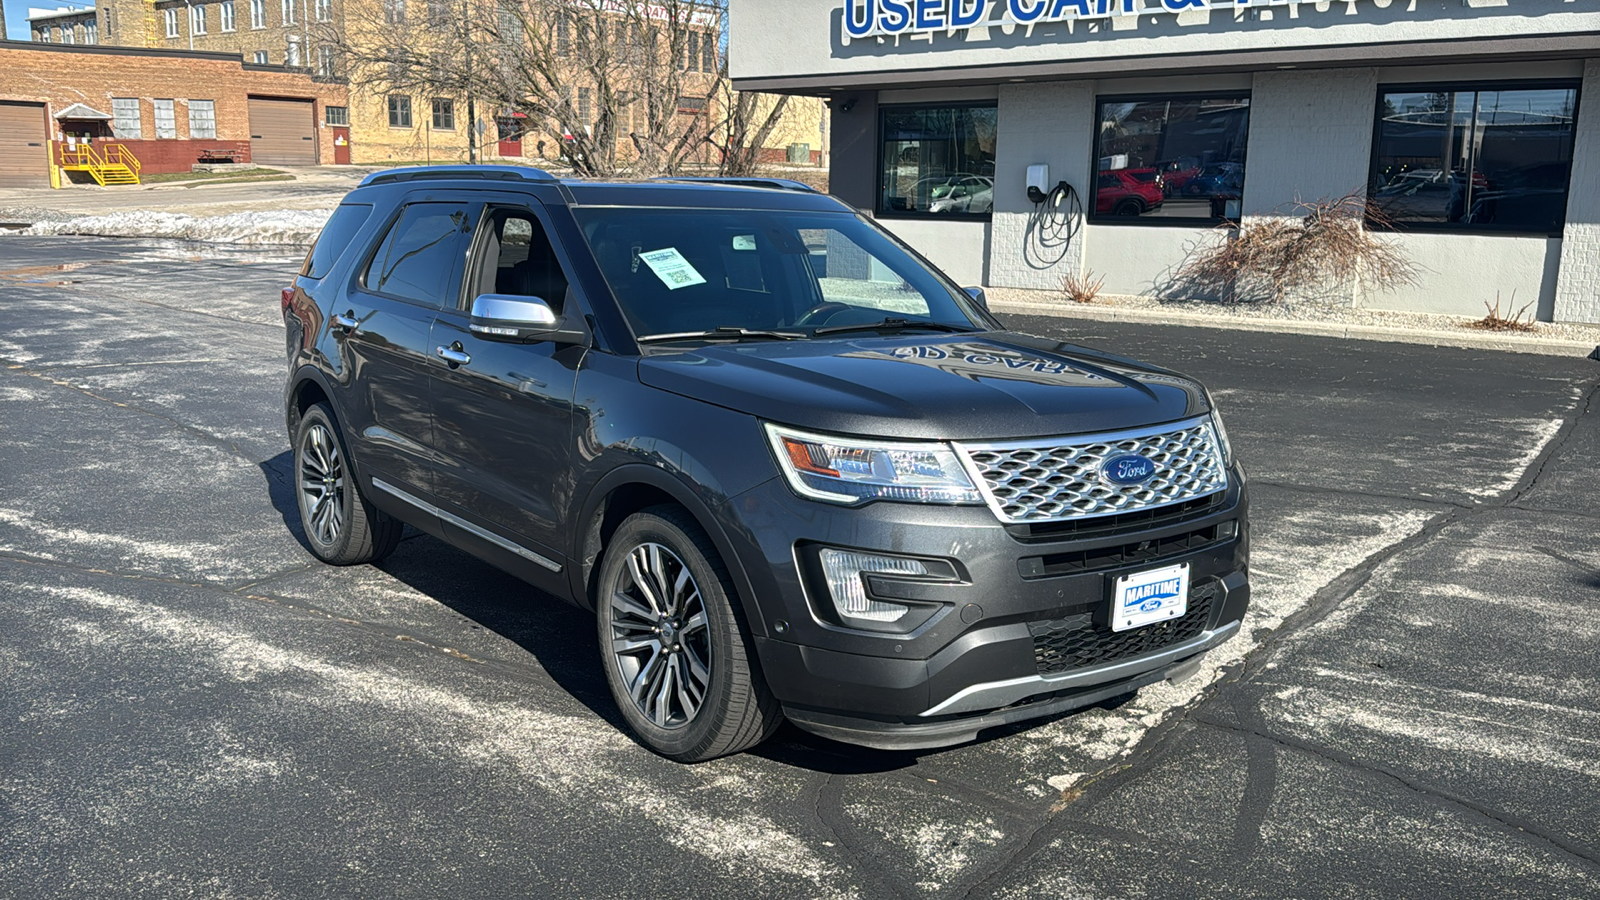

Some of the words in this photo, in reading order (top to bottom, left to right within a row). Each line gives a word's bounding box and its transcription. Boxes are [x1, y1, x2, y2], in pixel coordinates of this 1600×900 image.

[844, 0, 988, 38] USED
[1117, 459, 1148, 479] Ford
[1125, 578, 1180, 606] MARITIME
[1142, 600, 1161, 611] Ford
